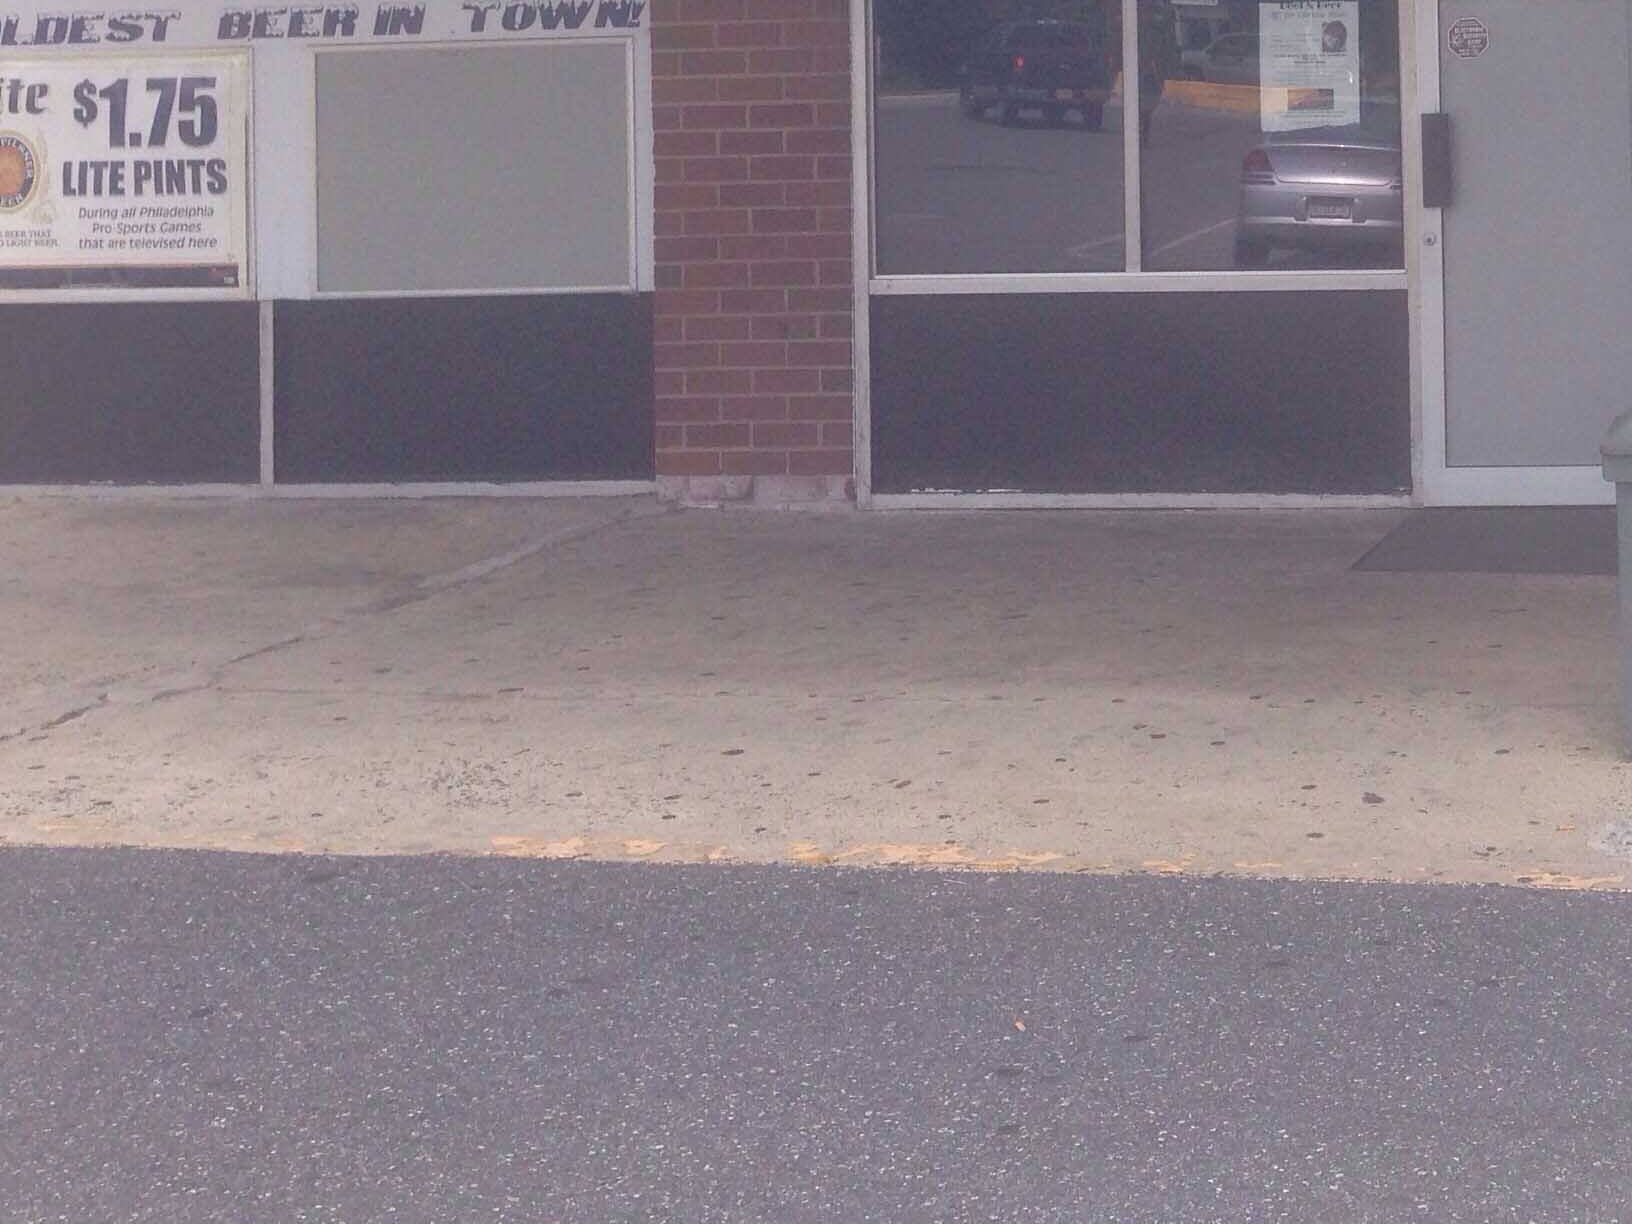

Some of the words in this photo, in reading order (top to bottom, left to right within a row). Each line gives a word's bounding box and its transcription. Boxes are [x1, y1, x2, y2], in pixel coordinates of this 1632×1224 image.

[0, 8, 183, 46] LDEST
[217, 3, 360, 41] BEER
[373, 1, 427, 36] IN
[73, 77, 218, 149] $1.75
[62, 160, 126, 197] LITE
[133, 158, 228, 196] PINTS
[79, 207, 118, 220] During
[121, 207, 136, 218] all
[139, 205, 215, 220] Philadelphia
[92, 223, 112, 234] Pro
[116, 222, 156, 236] Sports
[160, 221, 201, 233] Games
[79, 237, 104, 249] that
[107, 239, 127, 249] are
[129, 237, 185, 249] televised
[188, 236, 218, 248] here
